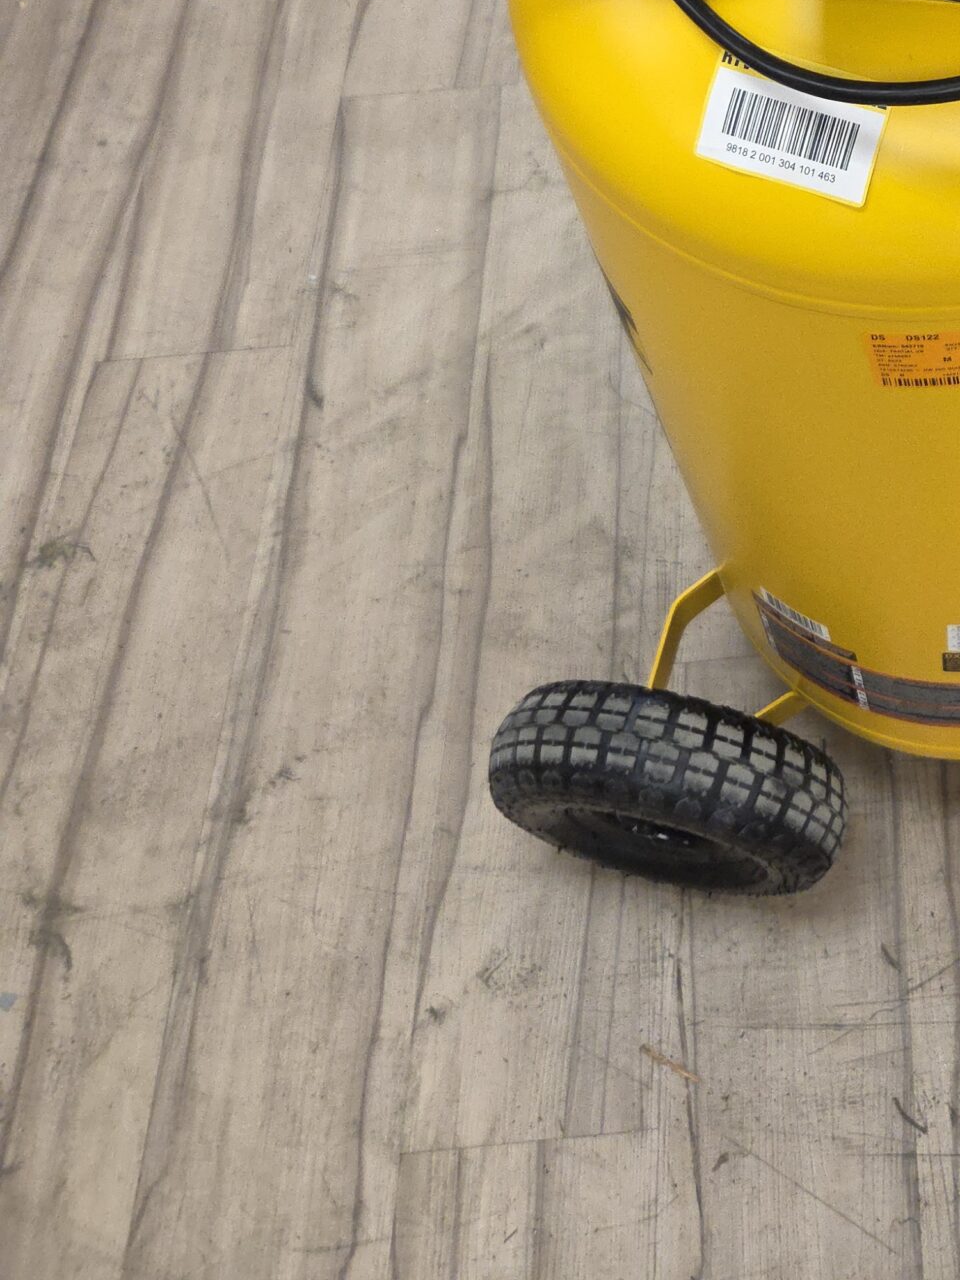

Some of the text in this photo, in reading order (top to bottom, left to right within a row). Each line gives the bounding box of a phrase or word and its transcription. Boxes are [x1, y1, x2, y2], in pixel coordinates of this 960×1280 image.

[726, 142, 836, 183] 9818 2 001 304 101 463
